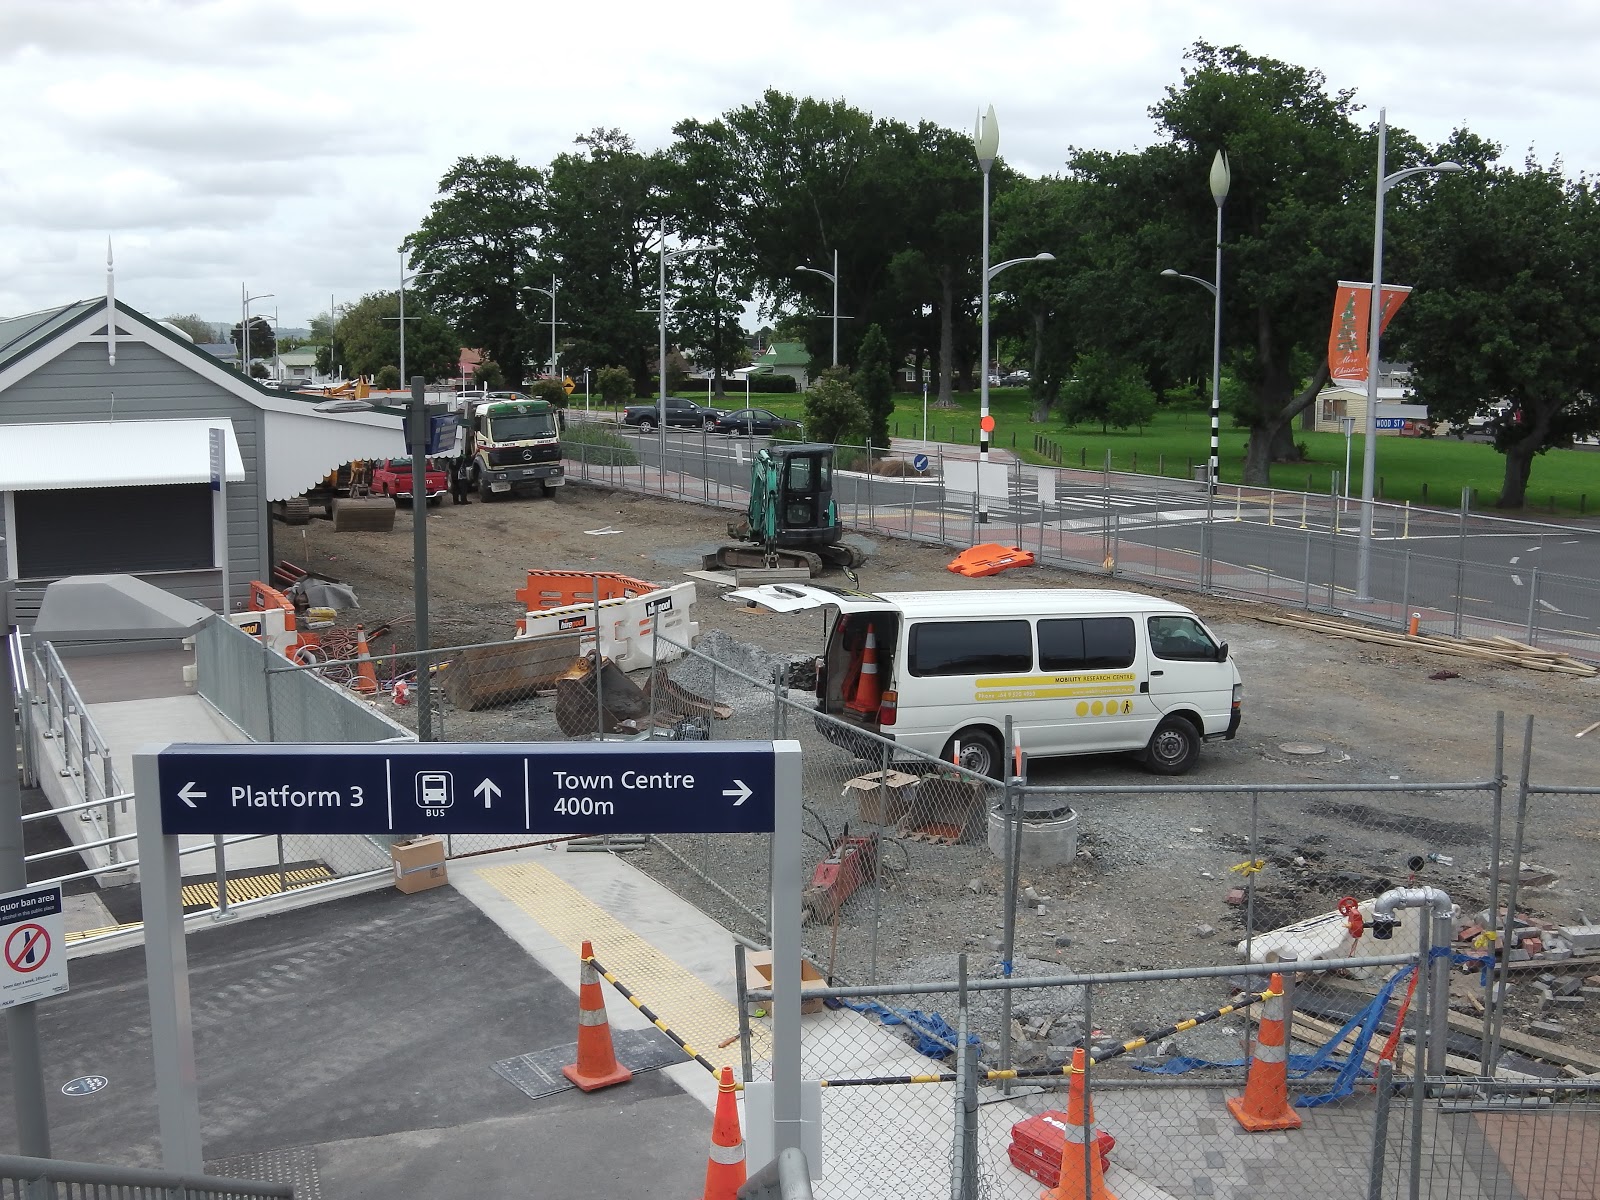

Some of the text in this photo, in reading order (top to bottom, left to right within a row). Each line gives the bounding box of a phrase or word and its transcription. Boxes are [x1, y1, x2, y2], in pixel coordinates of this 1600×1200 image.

[1376, 419, 1401, 428] WOOD ST
[552, 770, 695, 790] Town Centre
[231, 784, 364, 807] Platform 3
[426, 809, 445, 817] BUS
[553, 797, 614, 815] 400m
[0, 894, 55, 913] quor ban area
